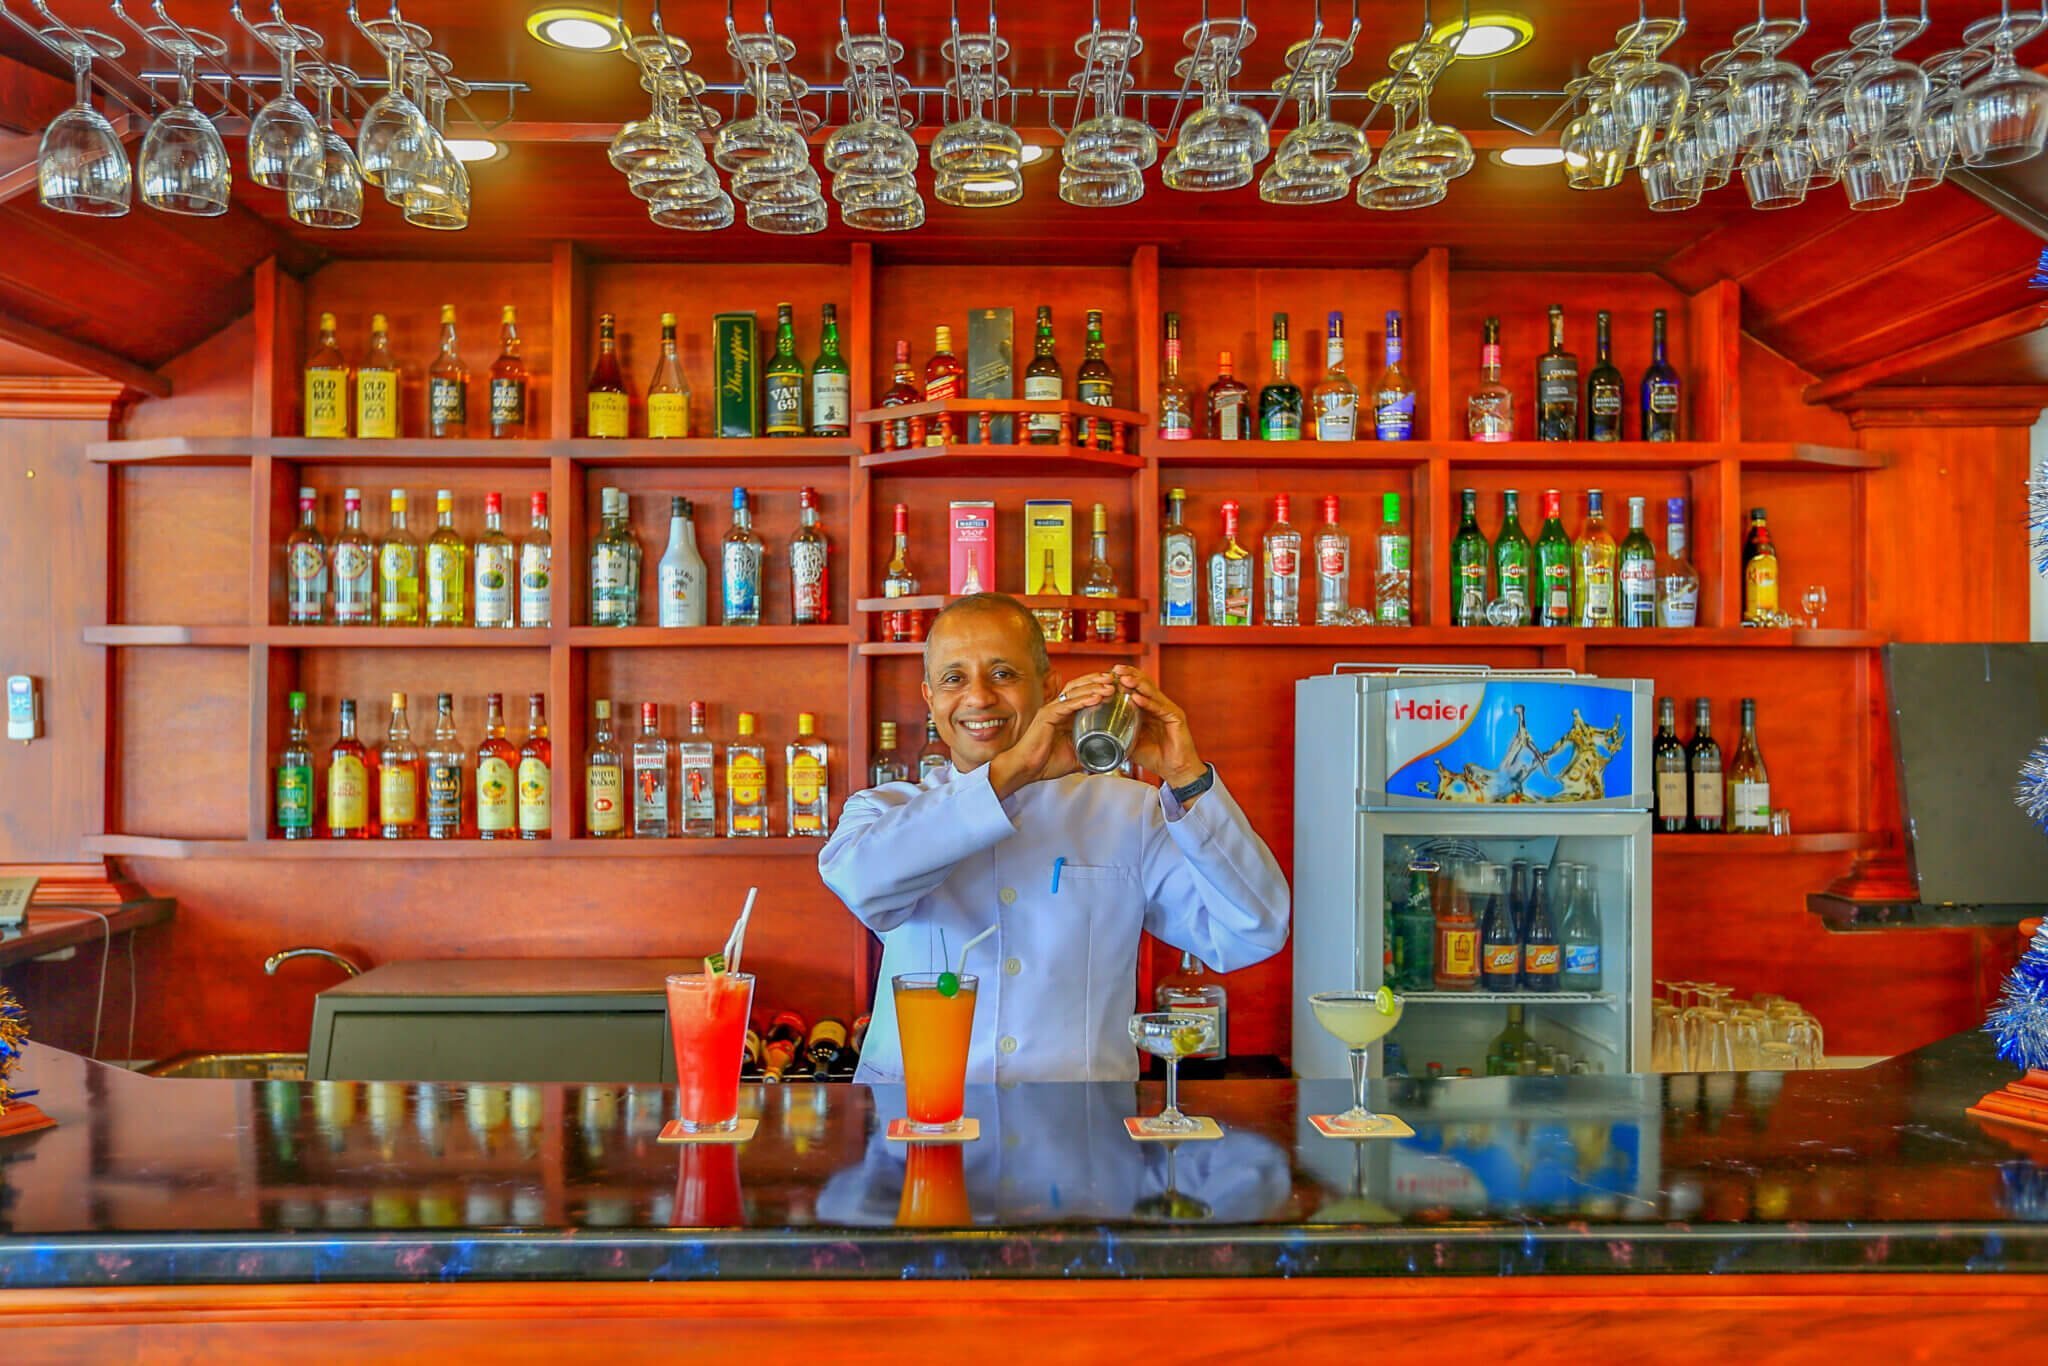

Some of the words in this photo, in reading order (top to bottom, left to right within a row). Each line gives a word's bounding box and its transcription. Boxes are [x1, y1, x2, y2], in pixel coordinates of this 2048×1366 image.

[313, 379, 336, 389] OLD
[770, 386, 801, 401] VAT
[777, 398, 798, 412] 69
[1084, 395, 1113, 408] VA
[1395, 699, 1469, 720] Haier
